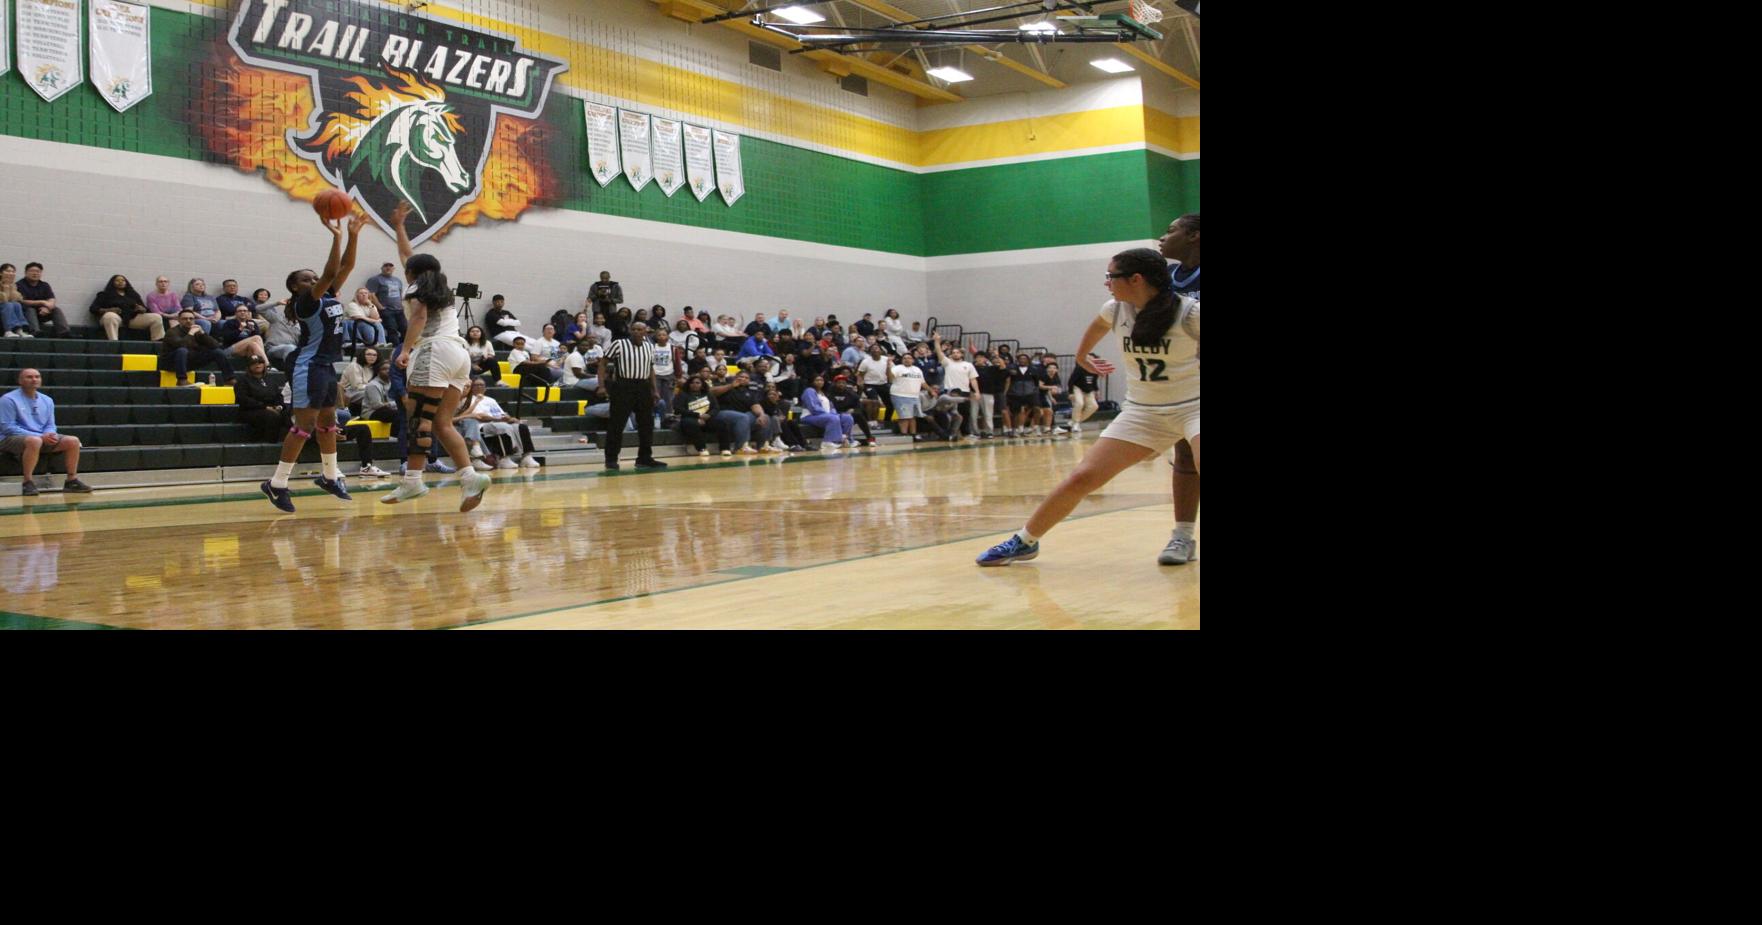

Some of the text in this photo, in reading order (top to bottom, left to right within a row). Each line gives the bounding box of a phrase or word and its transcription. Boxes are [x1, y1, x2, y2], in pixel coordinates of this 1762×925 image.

[252, 0, 534, 98] TRAIL BLAZERS
[446, 30, 512, 55] TRAIL
[1134, 357, 1169, 381] 12
